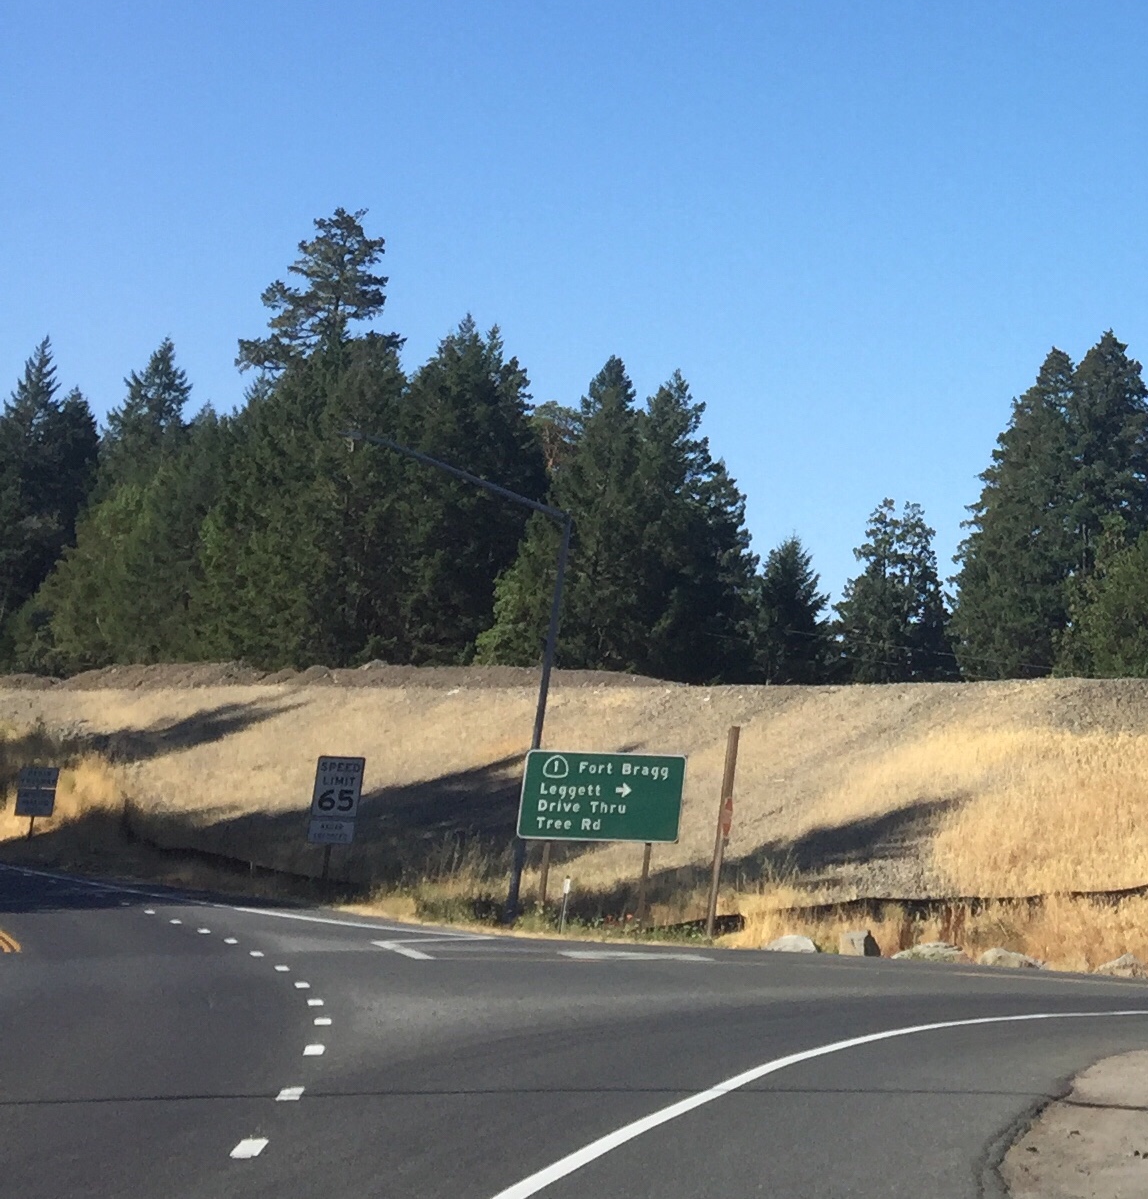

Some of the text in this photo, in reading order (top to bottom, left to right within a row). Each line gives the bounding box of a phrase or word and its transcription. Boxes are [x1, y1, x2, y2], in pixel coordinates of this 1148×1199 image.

[320, 762, 361, 773] SPEED
[553, 761, 669, 781] 1 Fort Bragg
[323, 776, 356, 787] LIMIT
[539, 782, 601, 799] Leggett
[317, 789, 355, 812] 65
[537, 799, 626, 814] Drive Thru
[536, 817, 601, 831] Tree Rd
